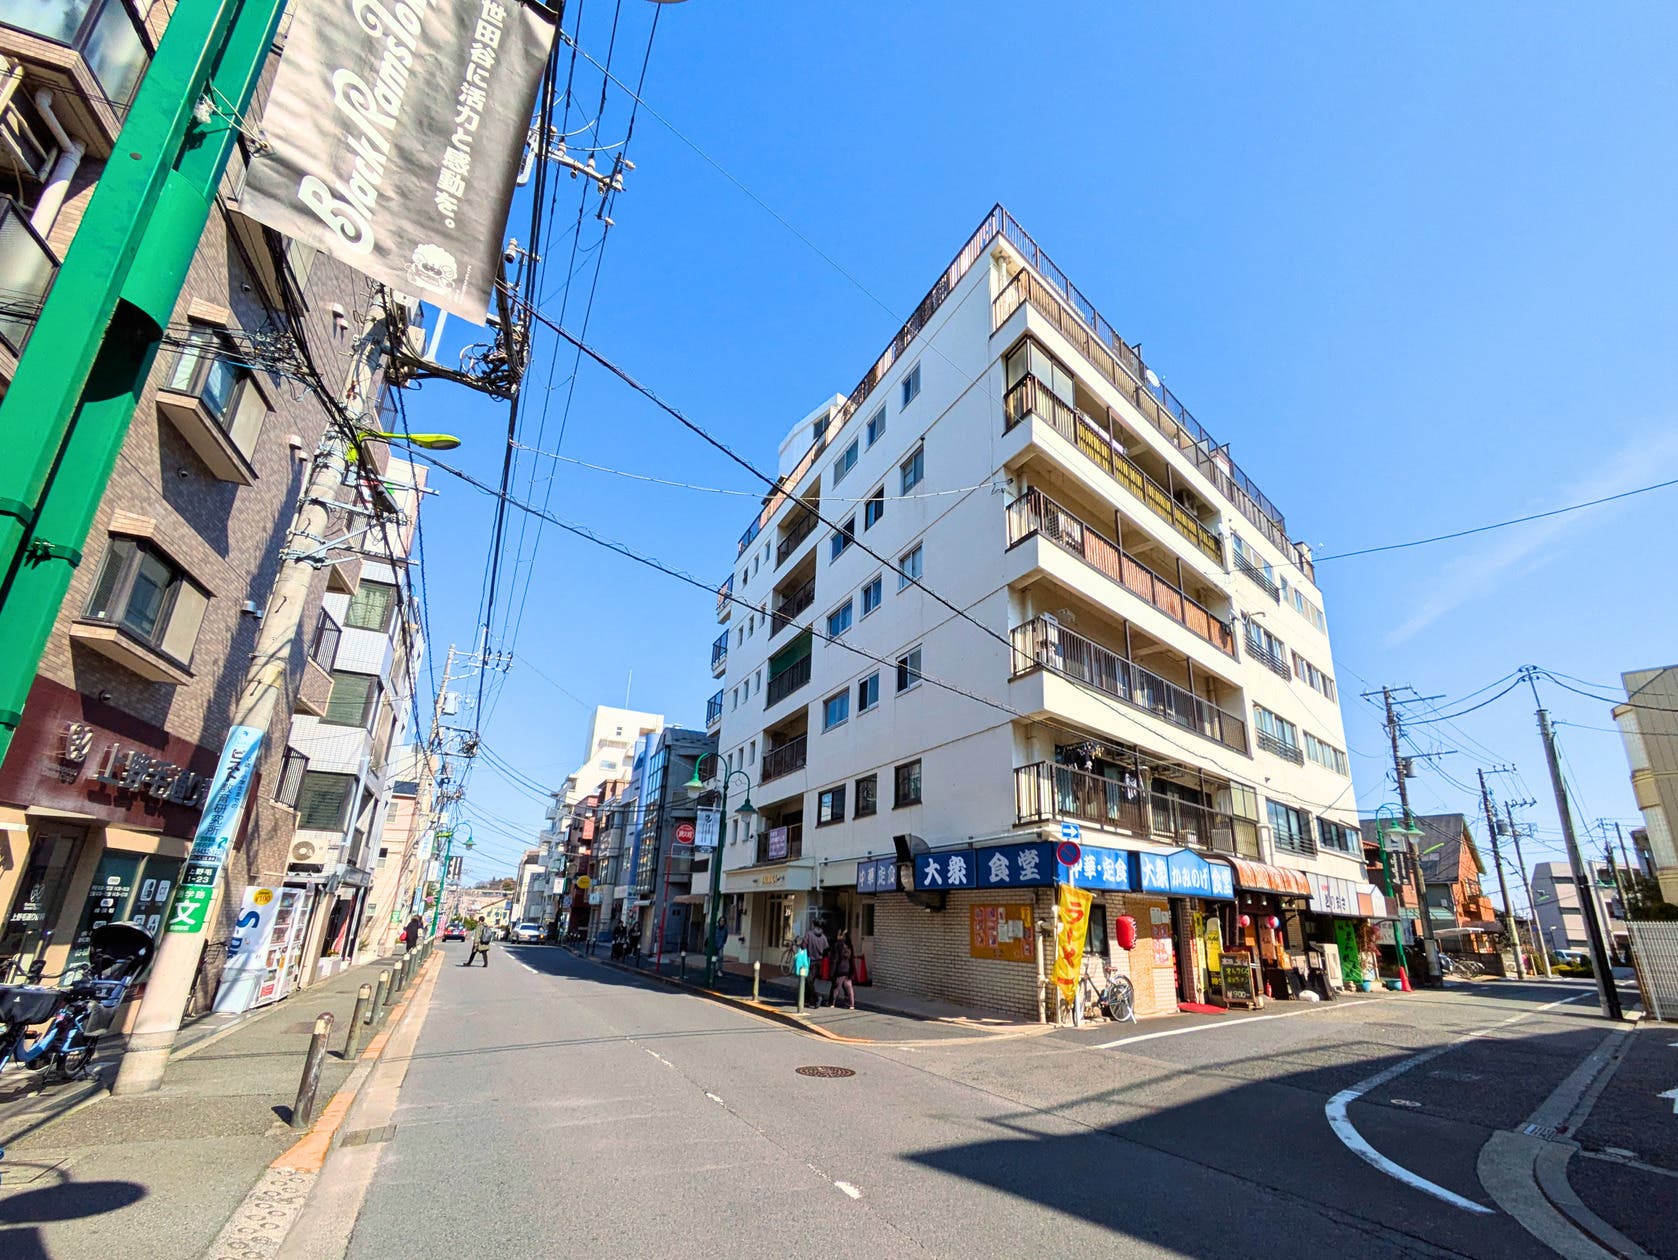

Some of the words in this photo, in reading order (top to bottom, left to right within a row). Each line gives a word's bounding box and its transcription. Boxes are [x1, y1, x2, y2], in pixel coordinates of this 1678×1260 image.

[332, 38, 414, 154] Rams
[297, 131, 388, 256] Black
[187, 876, 210, 884] 1-23
[189, 867, 213, 876] 上野毛
[168, 899, 201, 925] 文
